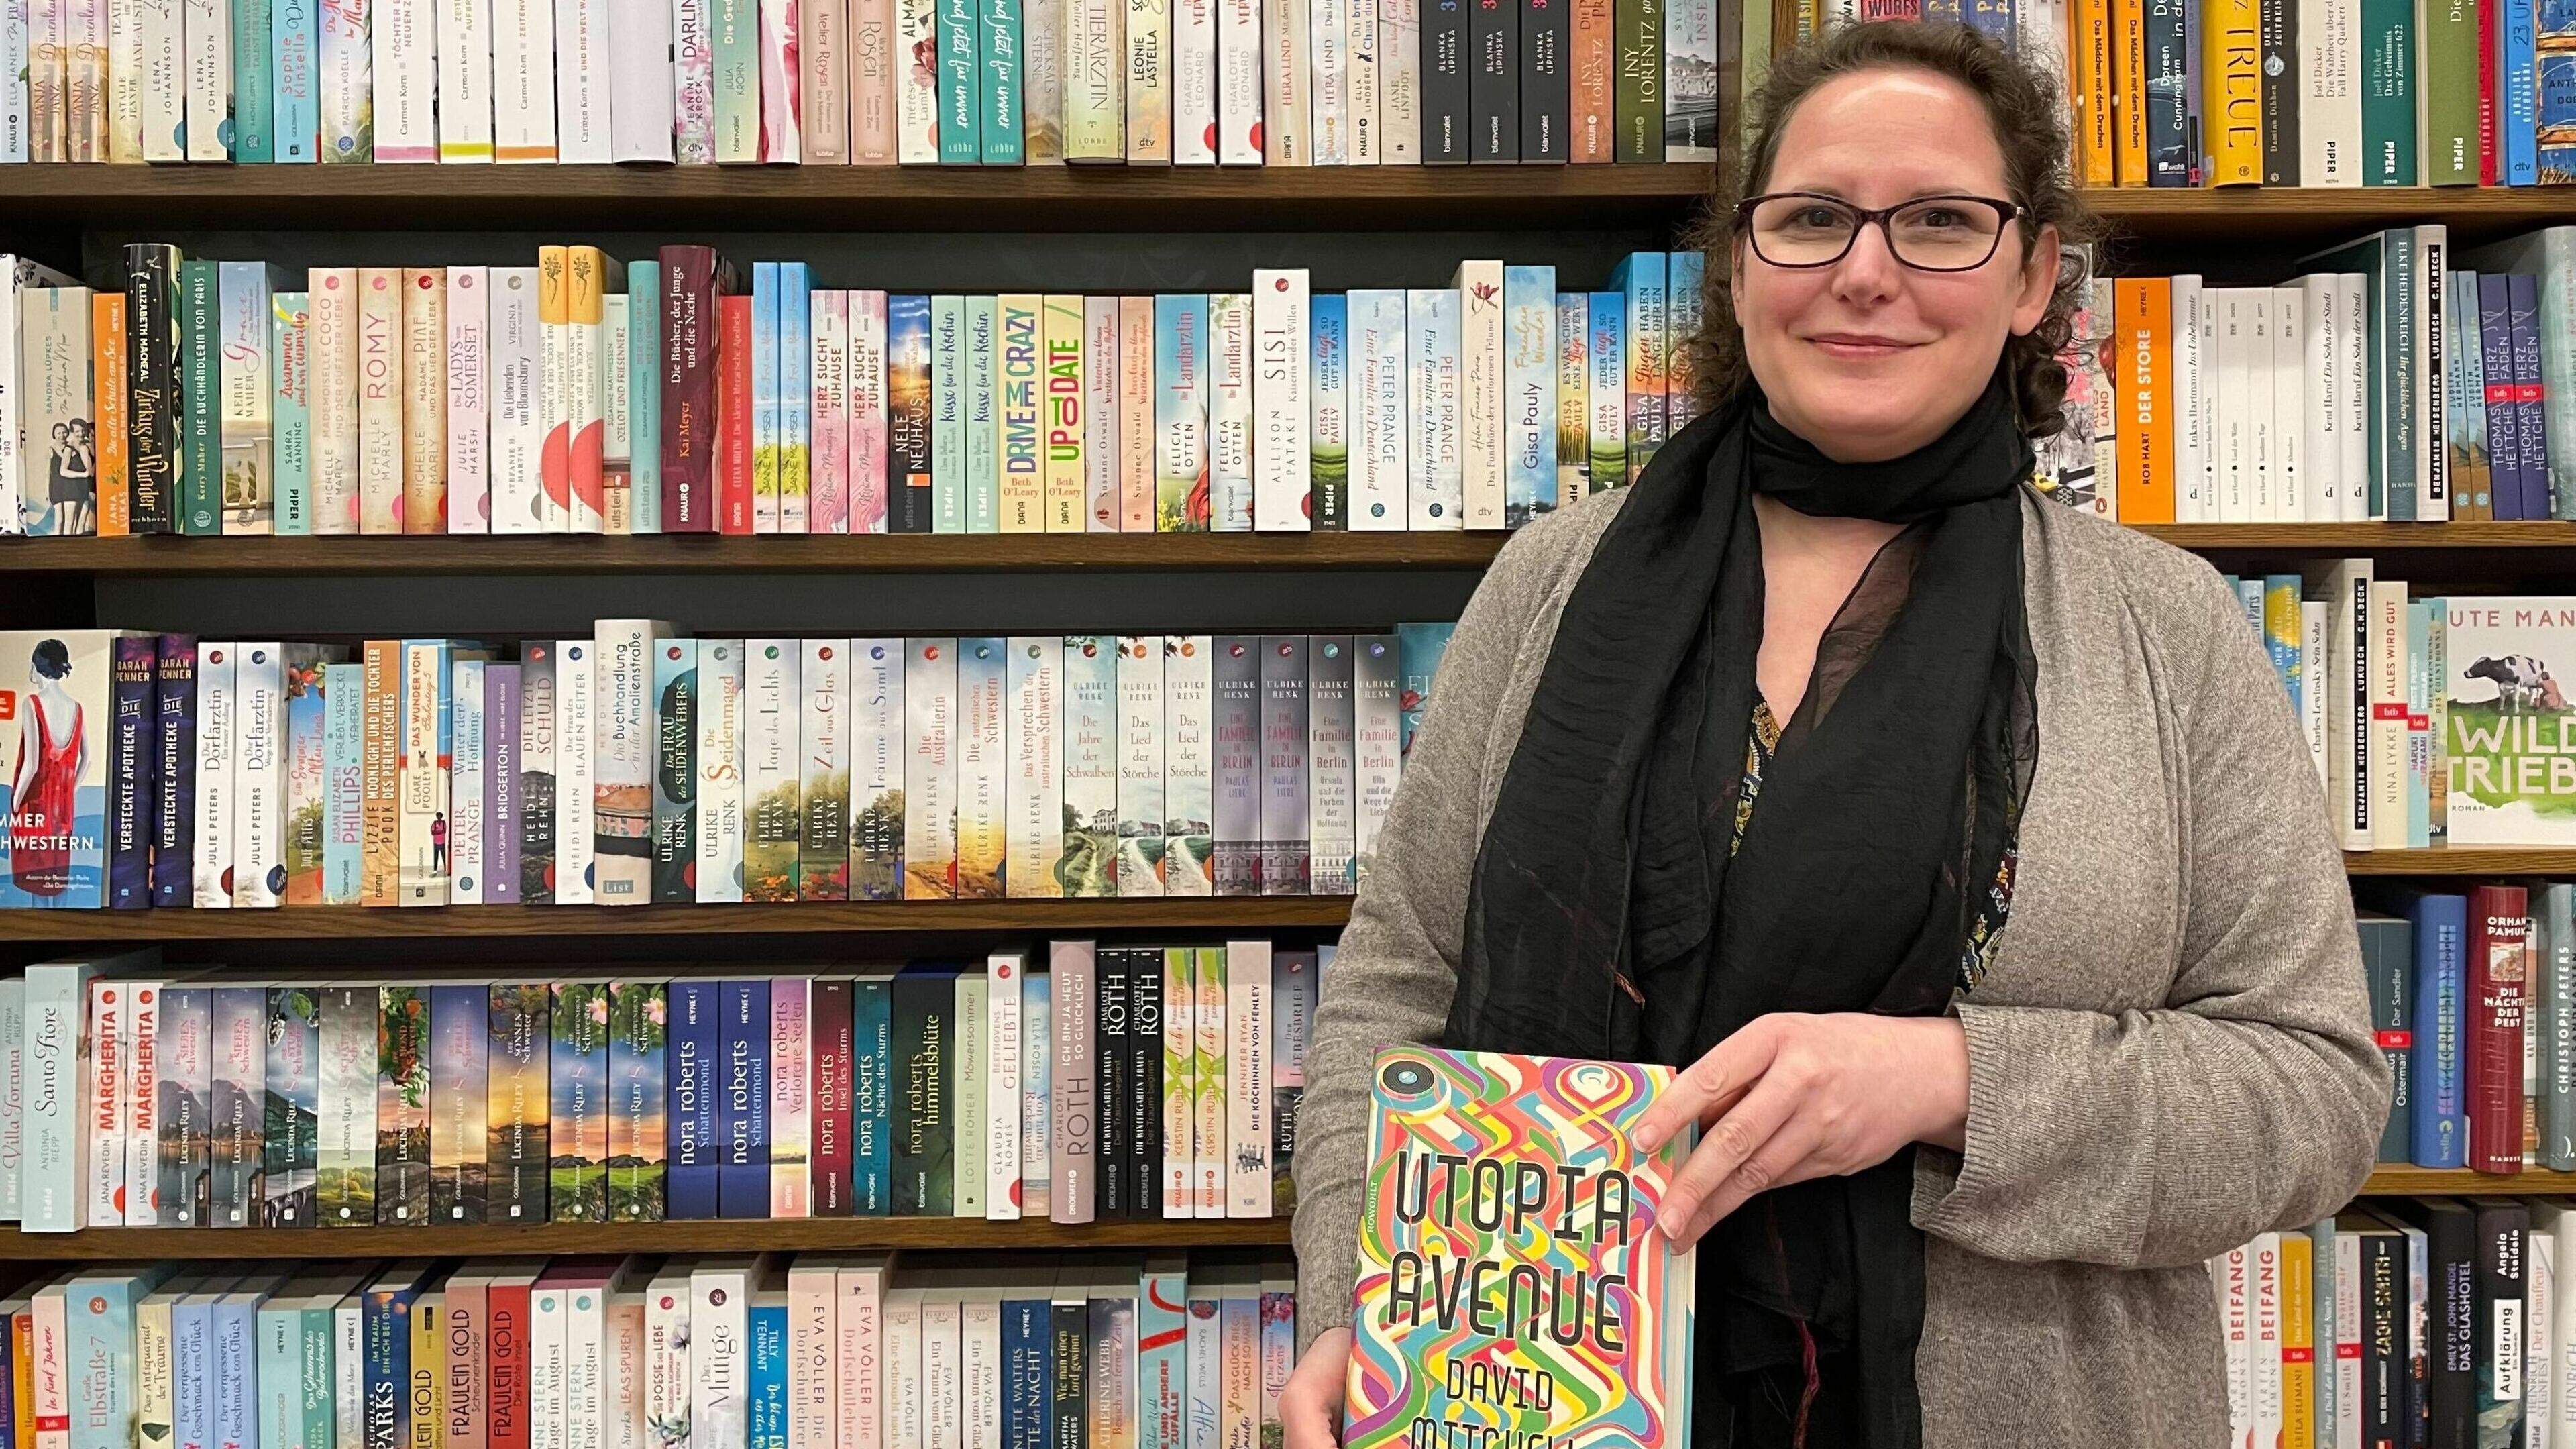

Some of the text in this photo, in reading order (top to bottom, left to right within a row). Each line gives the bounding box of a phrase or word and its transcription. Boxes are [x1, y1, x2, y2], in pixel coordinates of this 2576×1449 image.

[152, 60, 160, 91] LENA
[164, 36, 172, 115] JOHANNSON
[282, 38, 292, 93] Sophie
[294, 33, 305, 98] Kinsella
[1134, 37, 1144, 81] LEONIE
[1147, 30, 1157, 87] LASTELLA
[1625, 47, 1639, 78] INY
[1640, 21, 1654, 103] LORENTZ
[2161, 46, 2169, 87] Doreen
[399, 75, 408, 135] Carmen Korn
[2174, 58, 2184, 131] Cunningham
[2226, 29, 2257, 148] TREUE
[9, 124, 17, 152] KNAUR
[1139, 137, 1155, 148] dtv
[2385, 142, 2395, 174] PIPER
[195, 278, 204, 299] PARIS
[672, 266, 682, 295] Junge
[2399, 242, 2409, 352] ELKE HEIDENREICH
[138, 283, 148, 382] ELIZABETH MACNEAL
[195, 303, 204, 332] VON
[413, 316, 425, 354] PIAF
[672, 298, 681, 319] der
[685, 292, 695, 368] und die Nacht
[368, 313, 386, 398] ROMY
[451, 341, 463, 390] LADYS
[465, 325, 477, 409] SOMERSET
[1006, 307, 1035, 377] CRAZY
[1265, 329, 1286, 380] SISI
[2488, 346, 2497, 380] HERZ
[2500, 337, 2508, 380] FADEN
[671, 365, 681, 384] Die
[818, 337, 828, 418] HERZ SUCHT
[831, 348, 842, 408] ZUHAUSE
[1050, 339, 1079, 460] UP TO DATE
[2137, 329, 2152, 424] DER STORE
[679, 401, 691, 458] Kai Meyer
[895, 414, 908, 453] NELE
[910, 398, 923, 469] NEUHAUS
[1383, 356, 1395, 464] PETER PRANGE
[1523, 383, 1542, 469] Gisa Pauly
[1636, 396, 1648, 431] GISA
[1651, 396, 1662, 443] PAULY
[132, 390, 168, 511] Zirkus der Wunder
[1006, 411, 1036, 473] DRIVE
[1172, 423, 1180, 474] FELICIA
[1185, 423, 1193, 467] OTTEN
[2142, 432, 2151, 484] ROB HART
[2493, 409, 2502, 467] THOMAS
[2506, 407, 2515, 470] HETTCHE
[290, 489, 299, 520] PIPER
[680, 493, 688, 522] KNAUR
[1012, 478, 1031, 487] Beth
[2387, 600, 2395, 623] GUT
[2450, 610, 2500, 627] UTE
[2387, 627, 2395, 655] WIRD
[412, 651, 420, 747] DAS WUNDER VON
[538, 677, 551, 754] SCHULD
[1132, 716, 1149, 728] Das
[1130, 734, 1151, 745] Lied
[1132, 751, 1148, 762] der
[1313, 729, 1350, 741] Familie
[120, 724, 135, 851] VERSTECKTE APOTHEKE
[498, 745, 509, 820] BRIDGERTON
[1316, 757, 1347, 768] Berlin
[2387, 726, 2398, 803] NINA LYKKE
[662, 814, 673, 861] ULRIKE
[675, 813, 686, 847] RENK
[606, 883, 631, 892] List
[2488, 926, 2526, 936] PAMUK
[1062, 971, 1071, 1004] HEUT
[1062, 1008, 1070, 1019] JA
[1108, 975, 1125, 1036] ROTH
[2392, 969, 2401, 1026] Der Sandler
[2498, 1008, 2519, 1017] DER
[2501, 988, 2518, 996] DIE
[2495, 1018, 2520, 1026] PEST
[2559, 947, 2569, 1093] CHRISTOPH PETERS
[34, 1007, 60, 1117] Santo Fiore
[100, 1010, 116, 1130] MARGHERITA
[138, 1010, 153, 1130] MARGHERITA
[924, 1014, 939, 1126] himmelsblüte
[1076, 1045, 1084, 1060] SO
[676, 1040, 694, 1165] nora roberts
[699, 1059, 710, 1148] Schattenmond
[907, 1053, 922, 1155] nora roberts
[2397, 1053, 2406, 1106] Ostermair
[1068, 1077, 1089, 1156] ROTH
[1367, 1181, 1378, 1233] ROWOHLT
[1395, 1150, 1631, 1246] UTOPIA
[2497, 1233, 2507, 1276] Angela
[814, 1305, 824, 1336] EVA
[1388, 1251, 1626, 1352] AVENUE
[2231, 1250, 2244, 1341] BEIFANG
[2261, 1250, 2275, 1341] BEIFANG
[2459, 1260, 2471, 1372] DAS GLASHOTEL
[452, 1308, 469, 1354] GOLD
[757, 1320, 767, 1371] TENNANT
[769, 1329, 778, 1358] TILLY
[2500, 1307, 2513, 1393] Aufklärung
[1027, 1347, 1042, 1407] NACHT
[1446, 1359, 1554, 1412] DAVID
